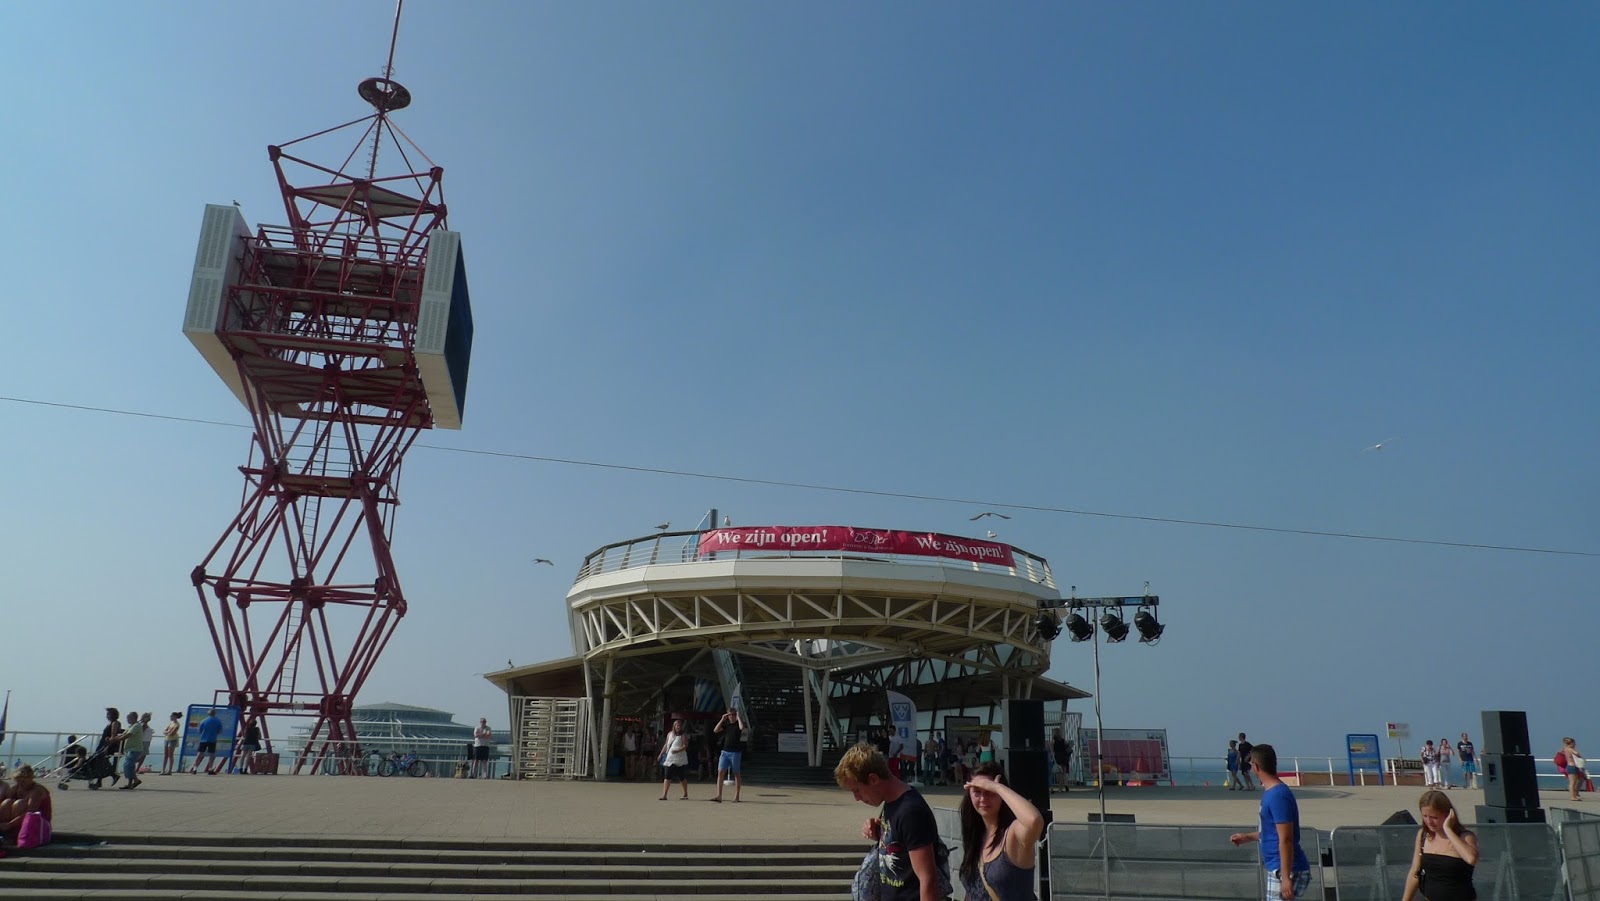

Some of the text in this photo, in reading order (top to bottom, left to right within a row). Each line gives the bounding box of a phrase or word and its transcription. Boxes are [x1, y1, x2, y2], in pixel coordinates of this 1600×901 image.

[718, 529, 828, 547] We zijn open!
[914, 536, 1004, 560] We zijn open!
[1388, 760, 1425, 769] TOIETTEN
